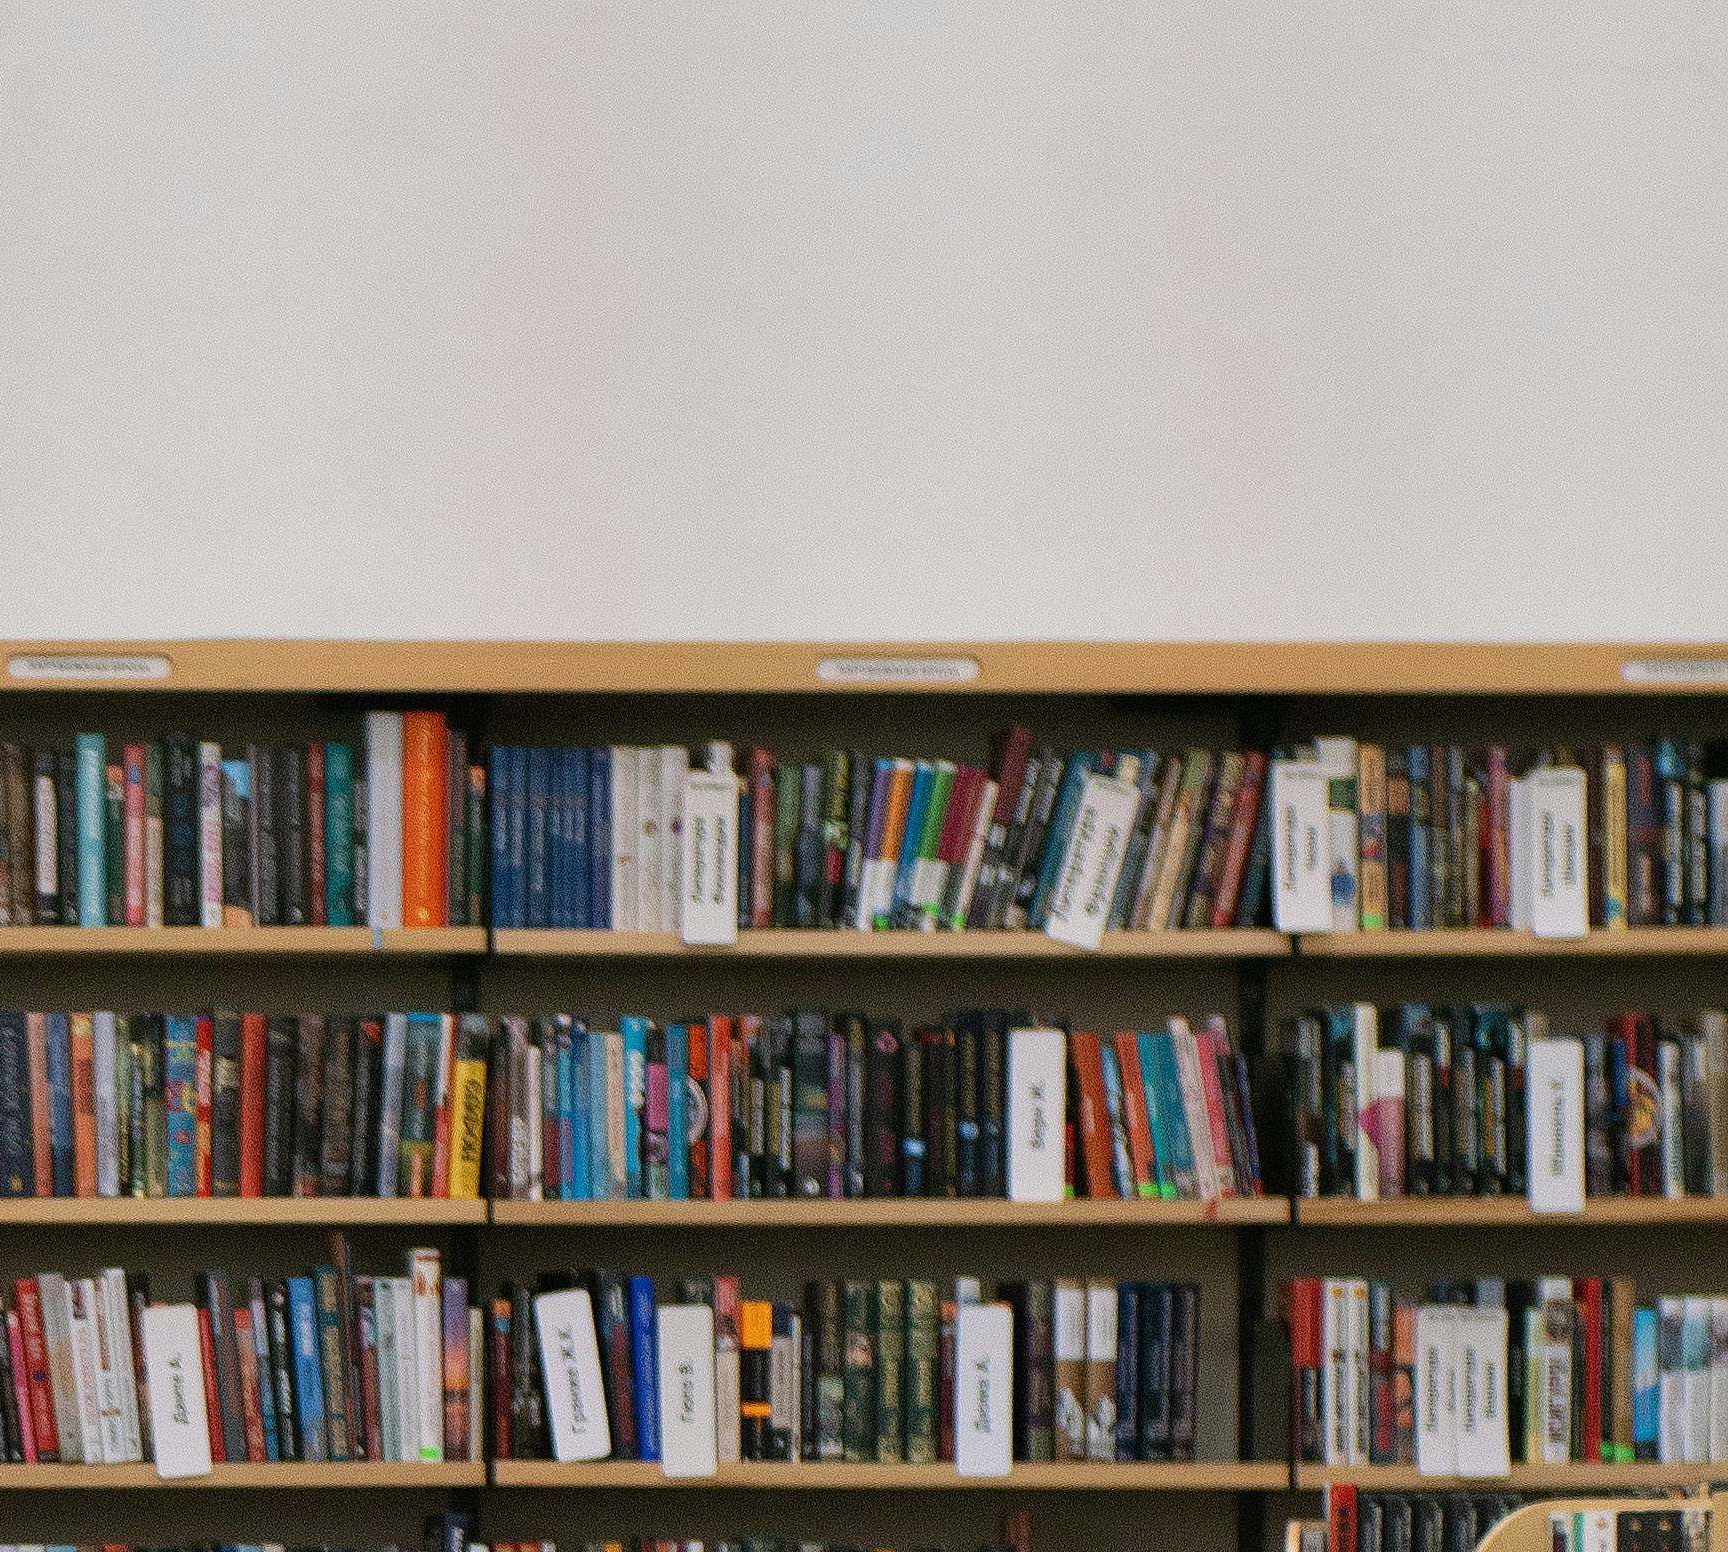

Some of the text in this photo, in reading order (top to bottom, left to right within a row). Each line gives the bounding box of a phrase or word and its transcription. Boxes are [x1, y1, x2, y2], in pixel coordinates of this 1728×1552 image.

[691, 816, 706, 902] Литература
[1053, 808, 1095, 919] Литература
[171, 1373, 190, 1426] Данте
